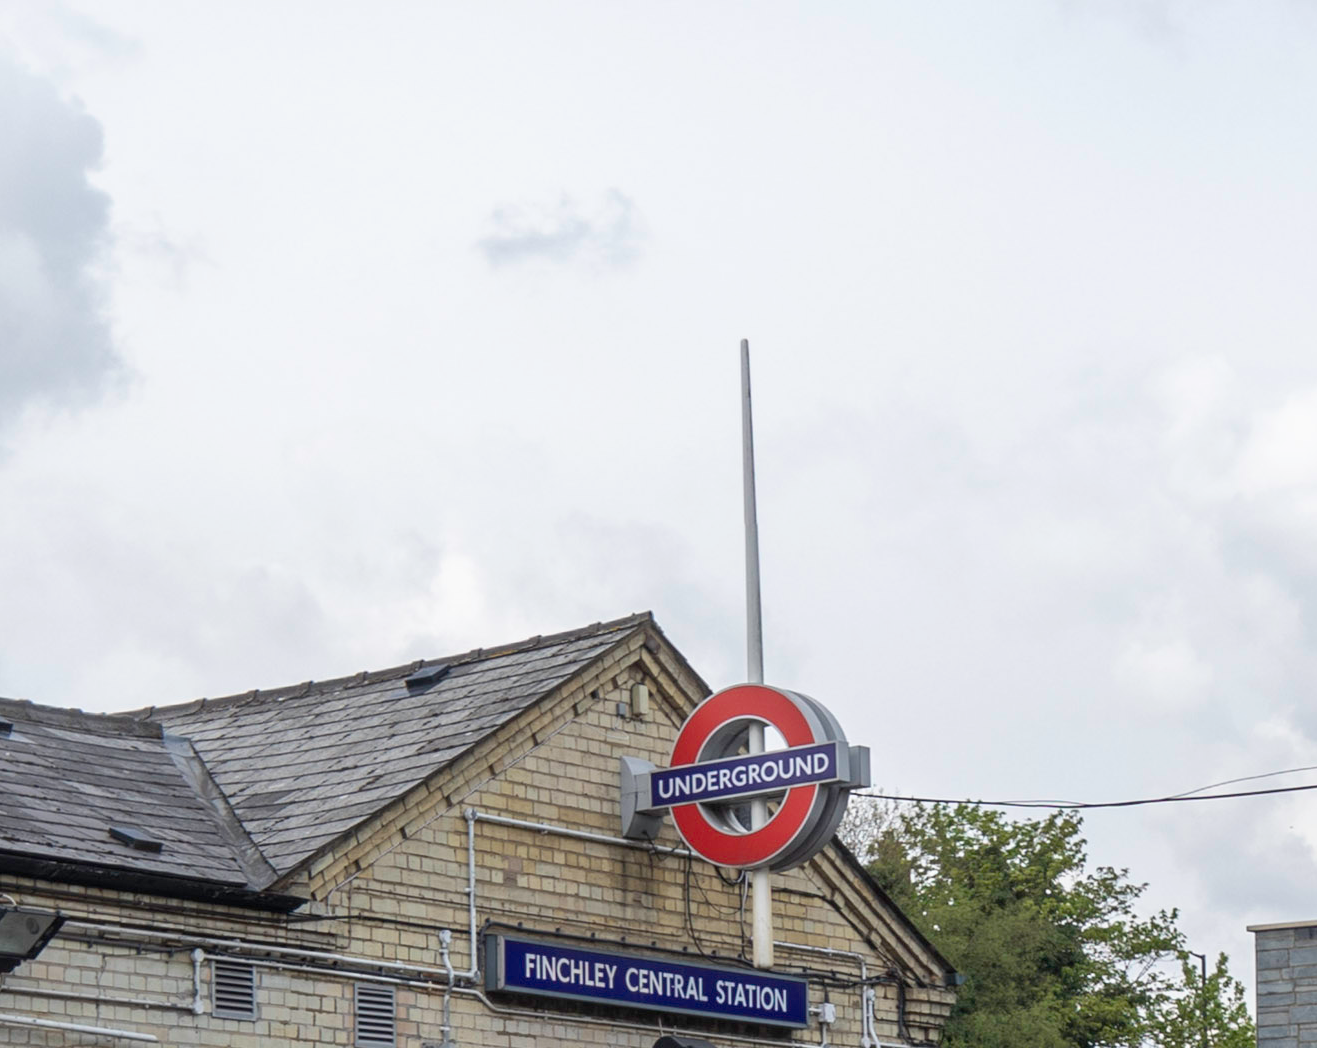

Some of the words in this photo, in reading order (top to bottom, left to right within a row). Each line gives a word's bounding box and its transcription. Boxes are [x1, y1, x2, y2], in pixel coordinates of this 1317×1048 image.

[658, 753, 830, 799] UNDERGROUND
[525, 953, 618, 989] FINCHLEY
[625, 967, 709, 1002] CENTRAL
[715, 980, 788, 1013] STATION
